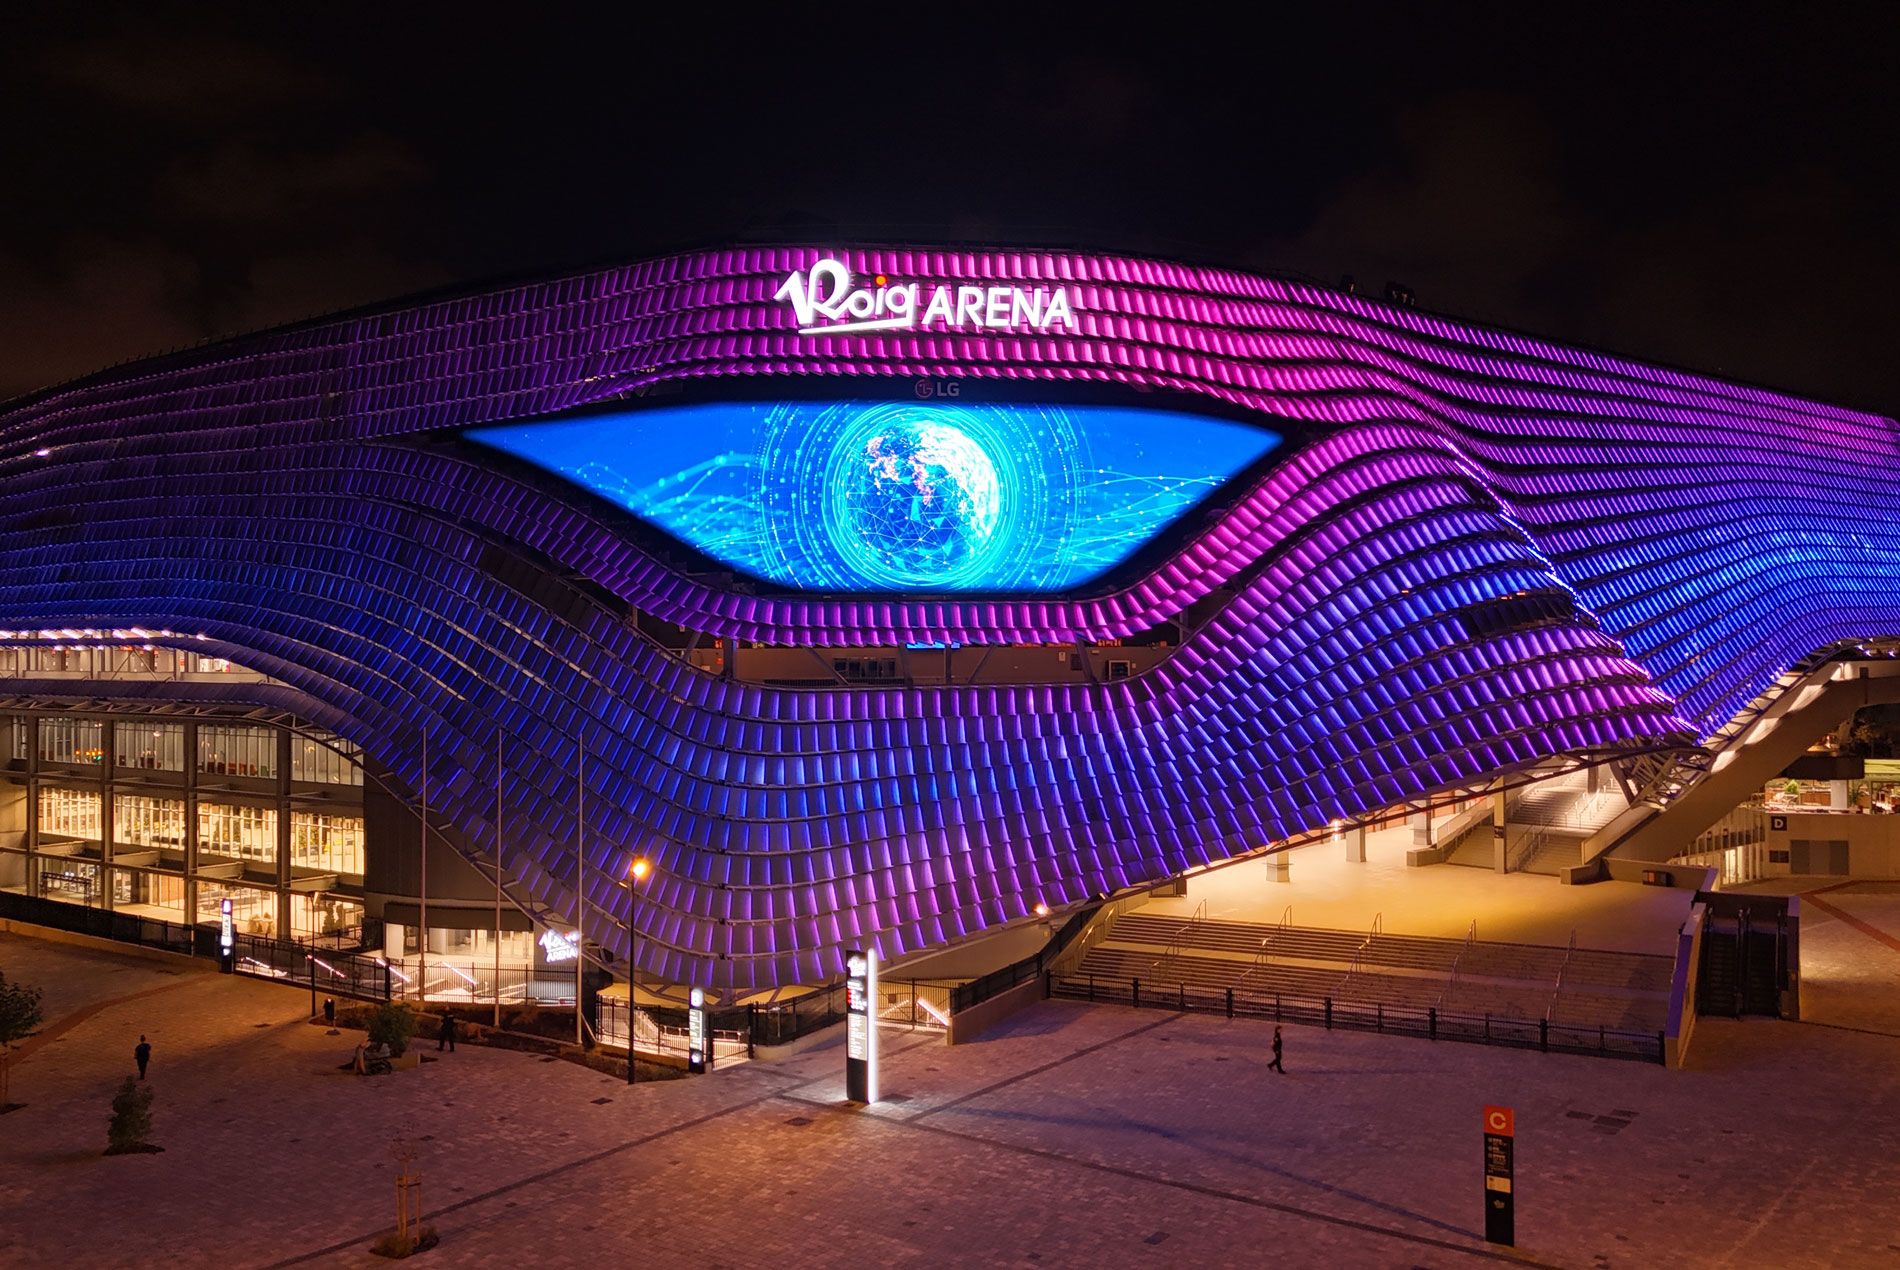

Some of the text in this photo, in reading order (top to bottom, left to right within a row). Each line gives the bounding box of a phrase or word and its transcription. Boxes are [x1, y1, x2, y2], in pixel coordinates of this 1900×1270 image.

[773, 258, 1073, 334] Roig ARENA
[937, 382, 960, 397] LG
[1774, 819, 1784, 828] D
[1489, 1112, 1507, 1130] C
